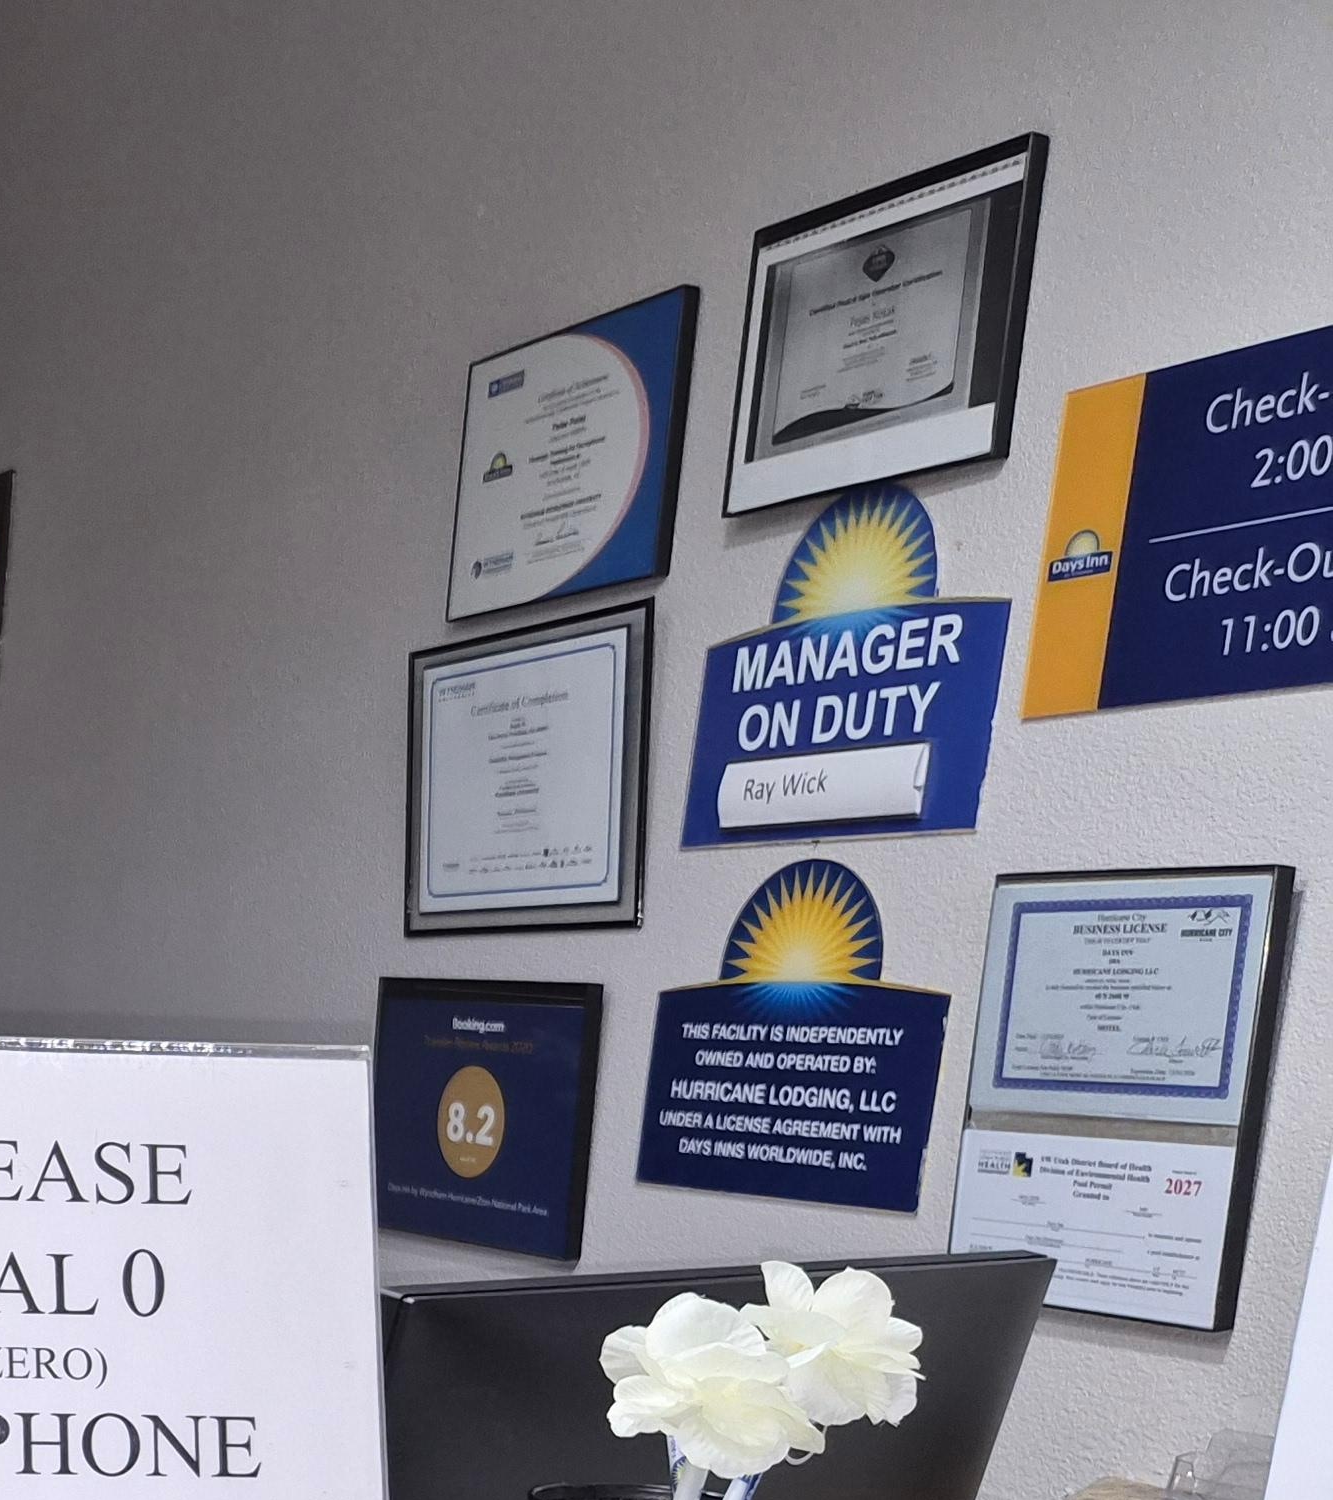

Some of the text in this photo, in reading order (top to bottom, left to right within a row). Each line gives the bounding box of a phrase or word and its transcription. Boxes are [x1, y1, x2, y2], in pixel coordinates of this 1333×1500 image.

[1206, 371, 1331, 433] Check-
[1251, 434, 1333, 489] 2:00
[1051, 554, 1109, 575] Days Inn
[1220, 605, 1321, 656] 11:00
[732, 613, 964, 694] MANAGER
[738, 681, 941, 751] ON DUTY
[743, 768, 829, 804] Ray Wick
[1073, 922, 1169, 936] BUSINESS LICENSE
[1180, 928, 1233, 938] HURRICANE CITY
[452, 1017, 506, 1033] Booking.com
[682, 1022, 905, 1046] THIS FACILITY IS INDEPENDENTLY
[694, 1049, 877, 1075] OWNED AND OPERATED BY:
[670, 1078, 898, 1113] HURRICANE LODGING, LLC
[445, 1101, 496, 1147] 8.2
[659, 1108, 903, 1144] UNDER A LICENSE AGREEMENT WITH
[678, 1137, 867, 1171] DAYS INNS WORLDWIDE, INC.
[977, 1161, 1012, 1171] HEALTH
[1164, 1177, 1203, 1197] 2027
[123, 1249, 165, 1317] 0
